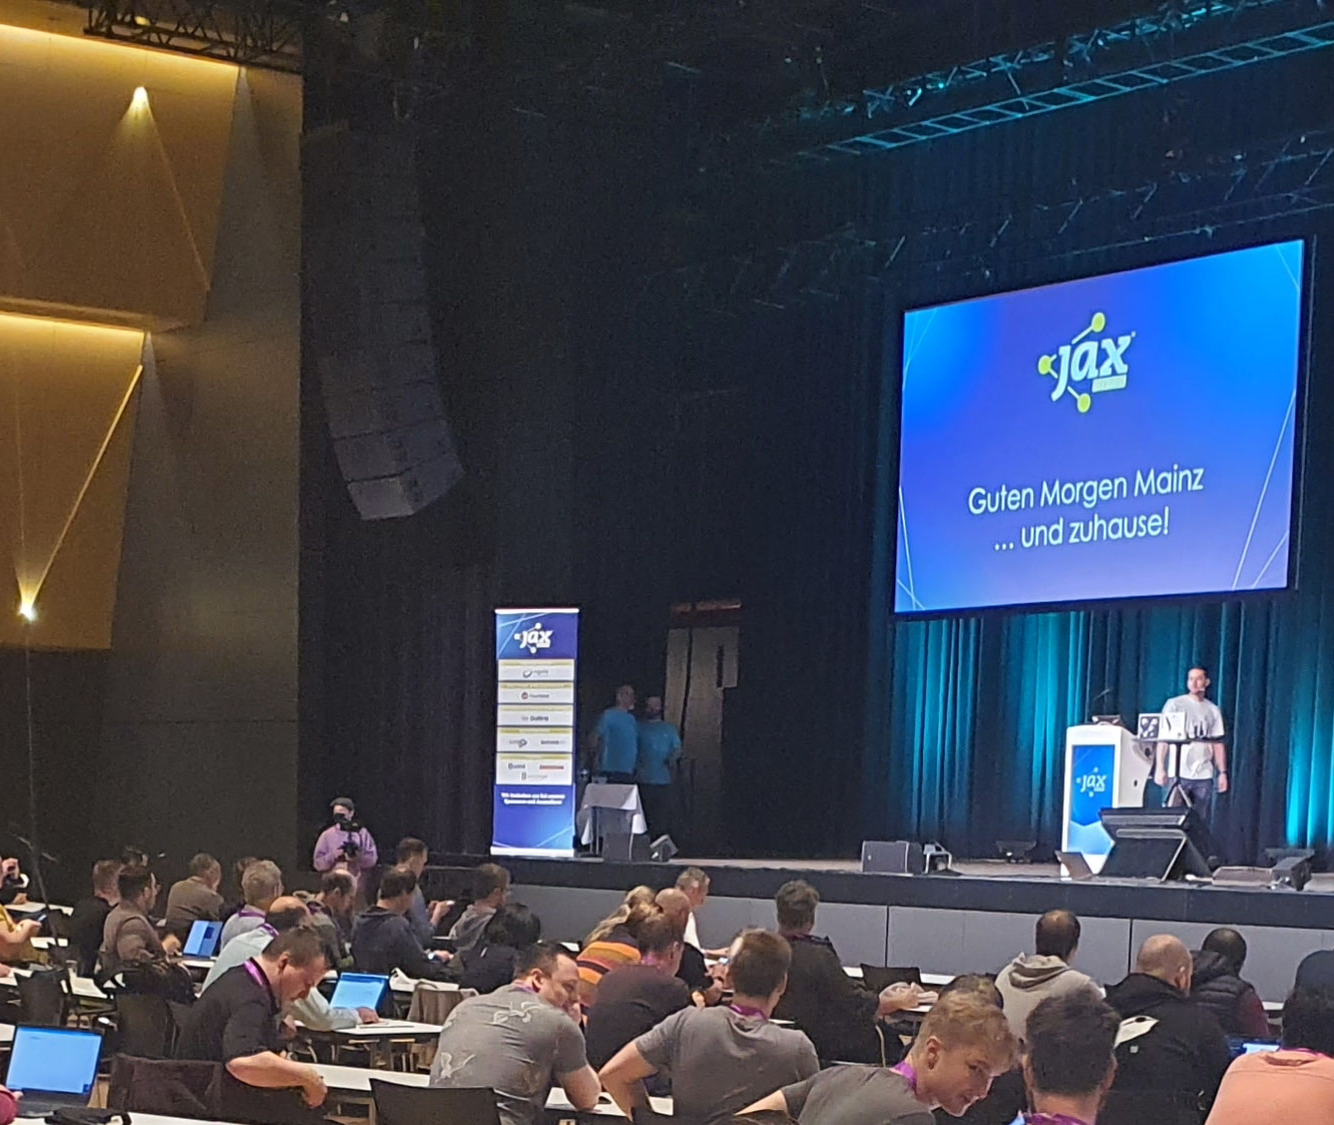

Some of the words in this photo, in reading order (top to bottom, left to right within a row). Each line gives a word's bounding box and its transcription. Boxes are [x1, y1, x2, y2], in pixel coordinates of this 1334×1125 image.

[1051, 335, 1131, 402] jax
[968, 484, 1034, 515] Guten
[1040, 477, 1127, 509] Morgen
[1134, 463, 1204, 497] Mainz
[1021, 516, 1064, 548] und
[1068, 506, 1170, 544] zuhause!
[520, 630, 553, 648] jax
[1080, 774, 1107, 792] jax
